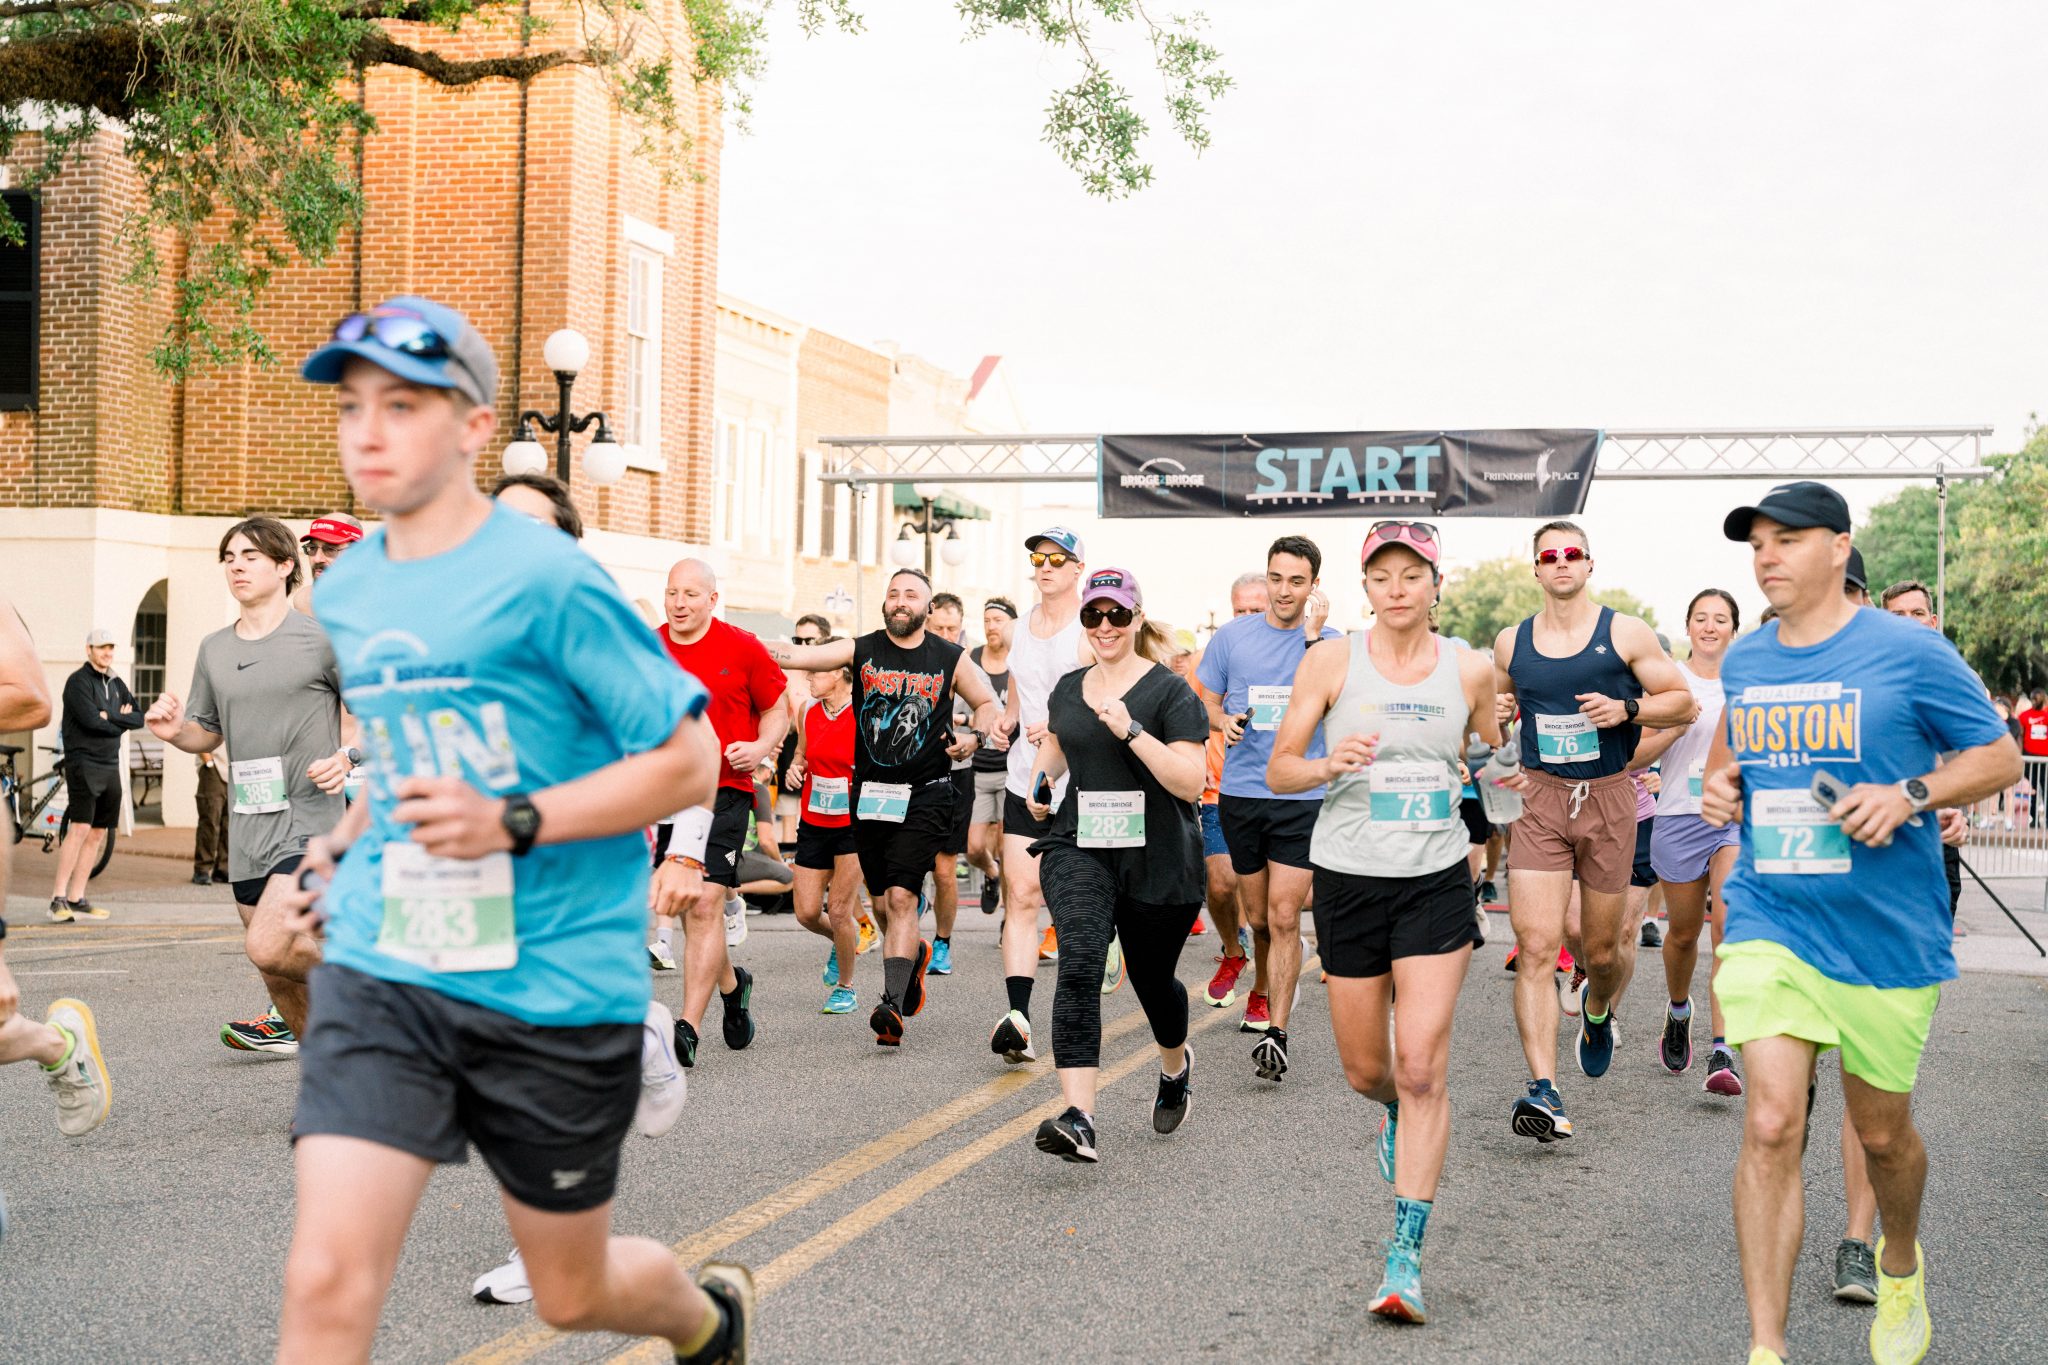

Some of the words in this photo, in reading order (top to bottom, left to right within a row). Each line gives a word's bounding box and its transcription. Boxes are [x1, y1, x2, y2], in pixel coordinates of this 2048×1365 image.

[1255, 445, 1441, 494] START
[1483, 471, 1536, 481] FRIENDSHIP
[1552, 471, 1580, 481] PLACE
[1120, 474, 1204, 487] BRIDGE2BRIDGE
[1750, 685, 1831, 700] QUALIFIER
[1271, 705, 1282, 722] 2
[1413, 703, 1445, 715] PROJECT
[1733, 703, 1854, 753] BOSTON
[1552, 735, 1579, 755] 76
[1768, 752, 1811, 768] 2024
[243, 782, 272, 804] 385
[819, 793, 834, 808] 87
[877, 798, 888, 813] 7
[1397, 793, 1431, 819] 73
[1091, 815, 1129, 838] 282
[1777, 826, 1815, 858] 72
[400, 899, 479, 947] 283
